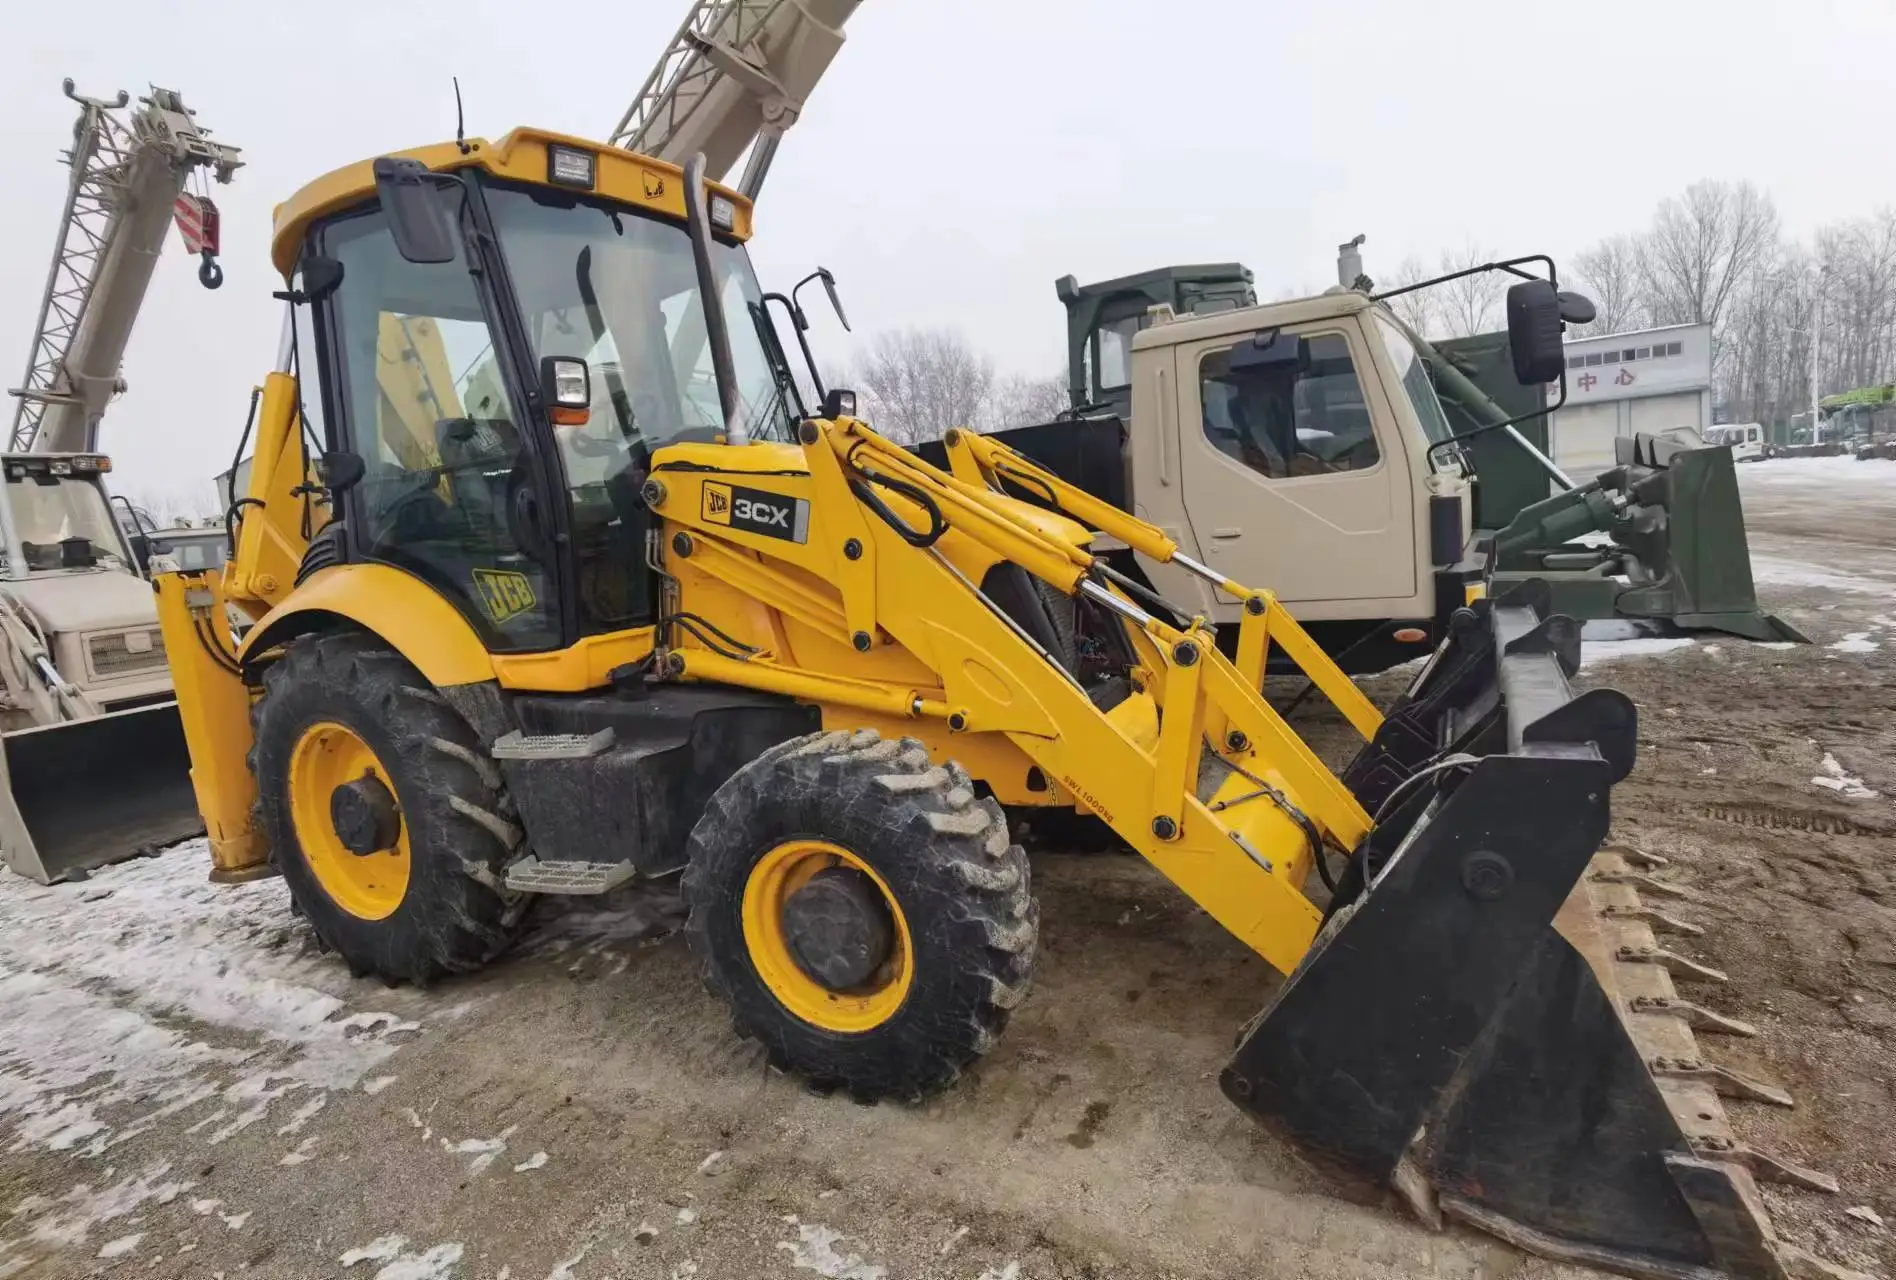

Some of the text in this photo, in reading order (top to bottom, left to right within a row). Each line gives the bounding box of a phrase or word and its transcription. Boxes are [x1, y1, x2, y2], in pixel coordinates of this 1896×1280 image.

[709, 491, 789, 528] JCB 3CX
[482, 572, 534, 619] JCB
